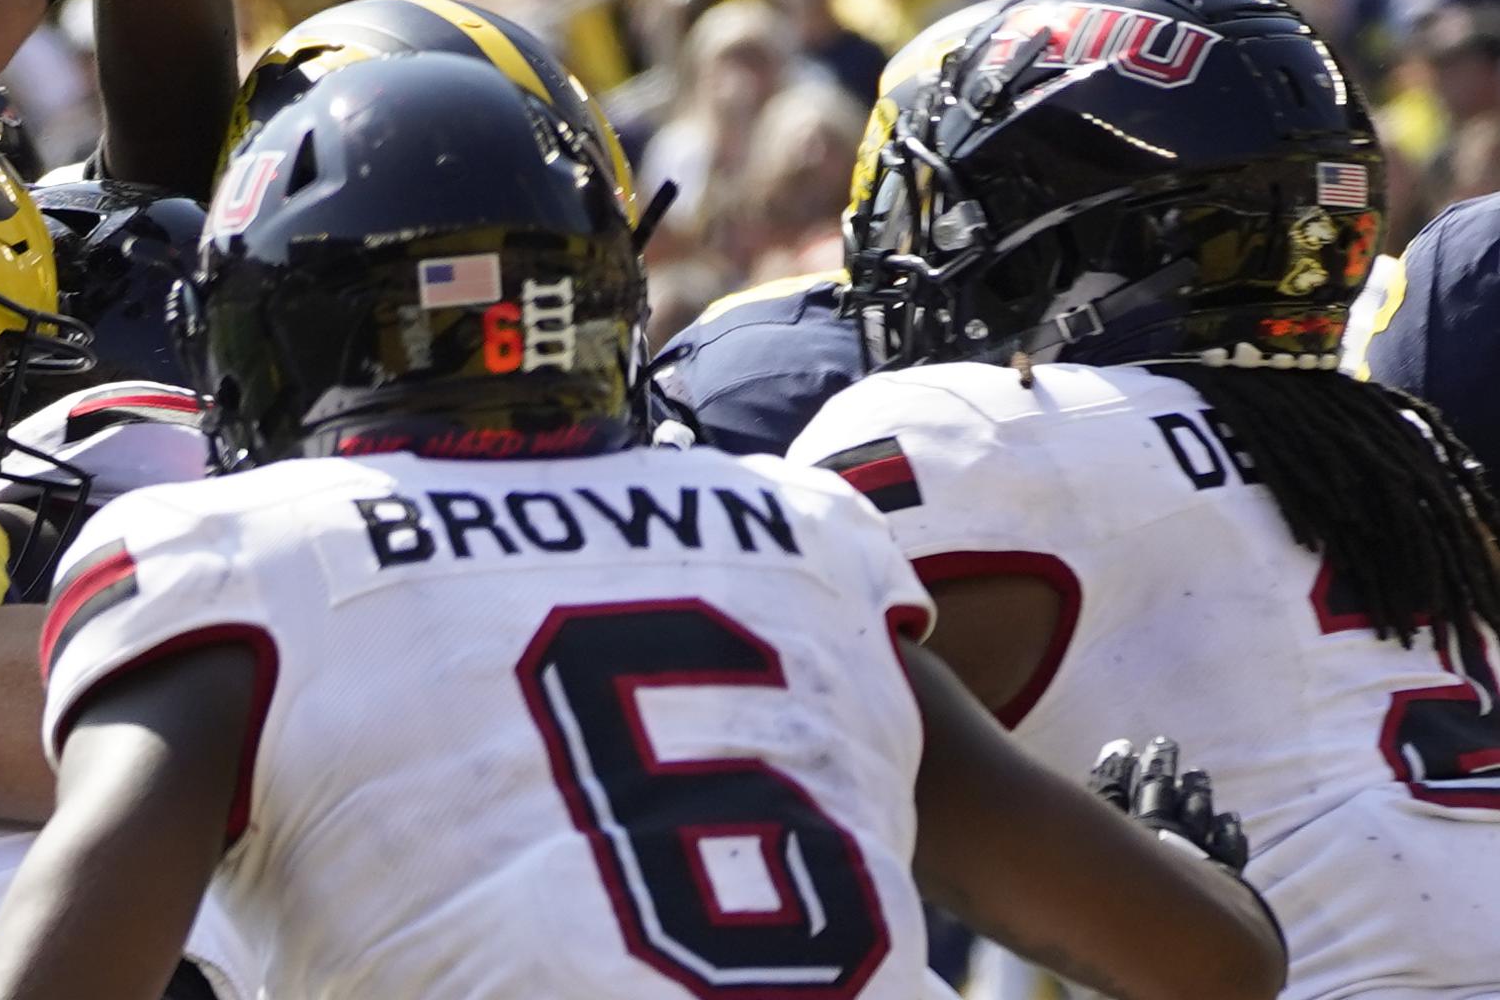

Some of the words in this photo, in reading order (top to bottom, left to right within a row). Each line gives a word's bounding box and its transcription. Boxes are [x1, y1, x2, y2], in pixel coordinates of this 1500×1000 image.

[482, 301, 525, 375] 6
[353, 486, 804, 571] BROWN
[513, 596, 893, 1000] 6
